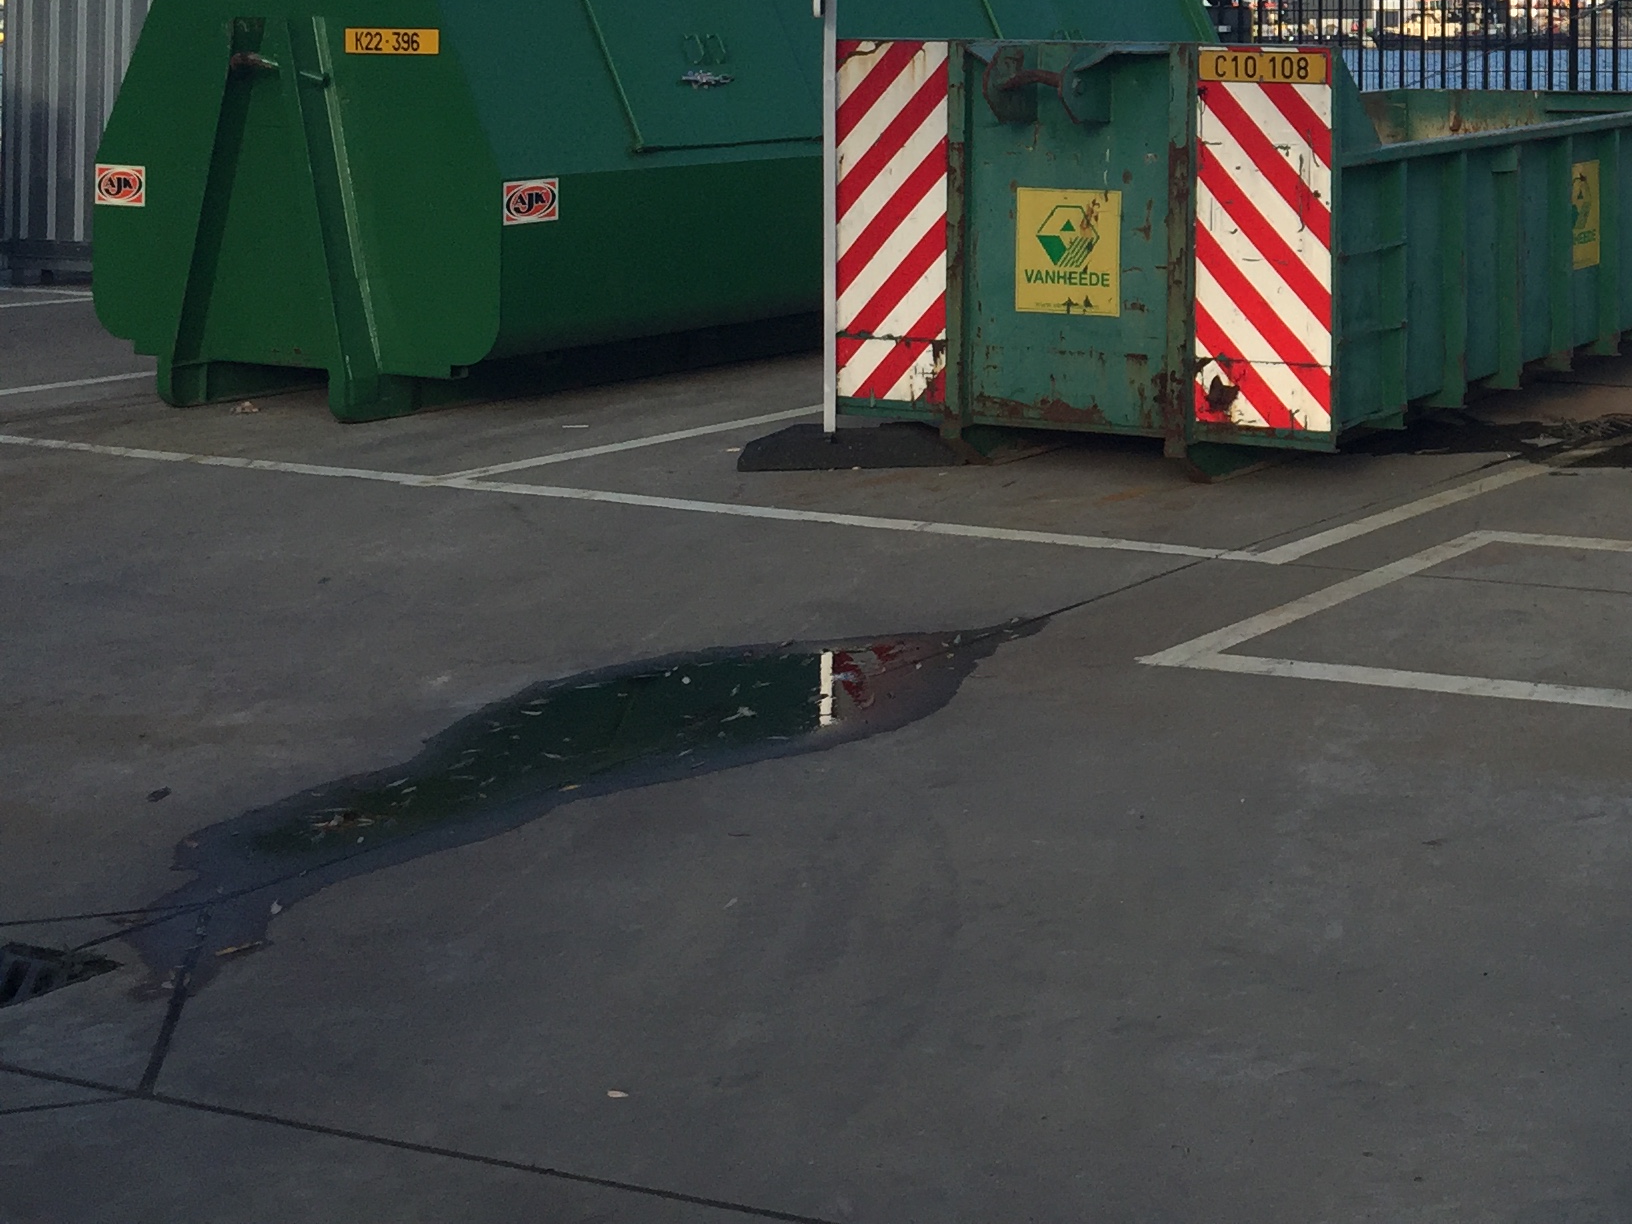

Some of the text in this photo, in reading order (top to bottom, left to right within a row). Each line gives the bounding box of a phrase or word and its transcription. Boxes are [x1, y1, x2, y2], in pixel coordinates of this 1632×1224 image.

[1215, 54, 1309, 80] C10 108
[1023, 268, 1111, 288] VANHEEDE
